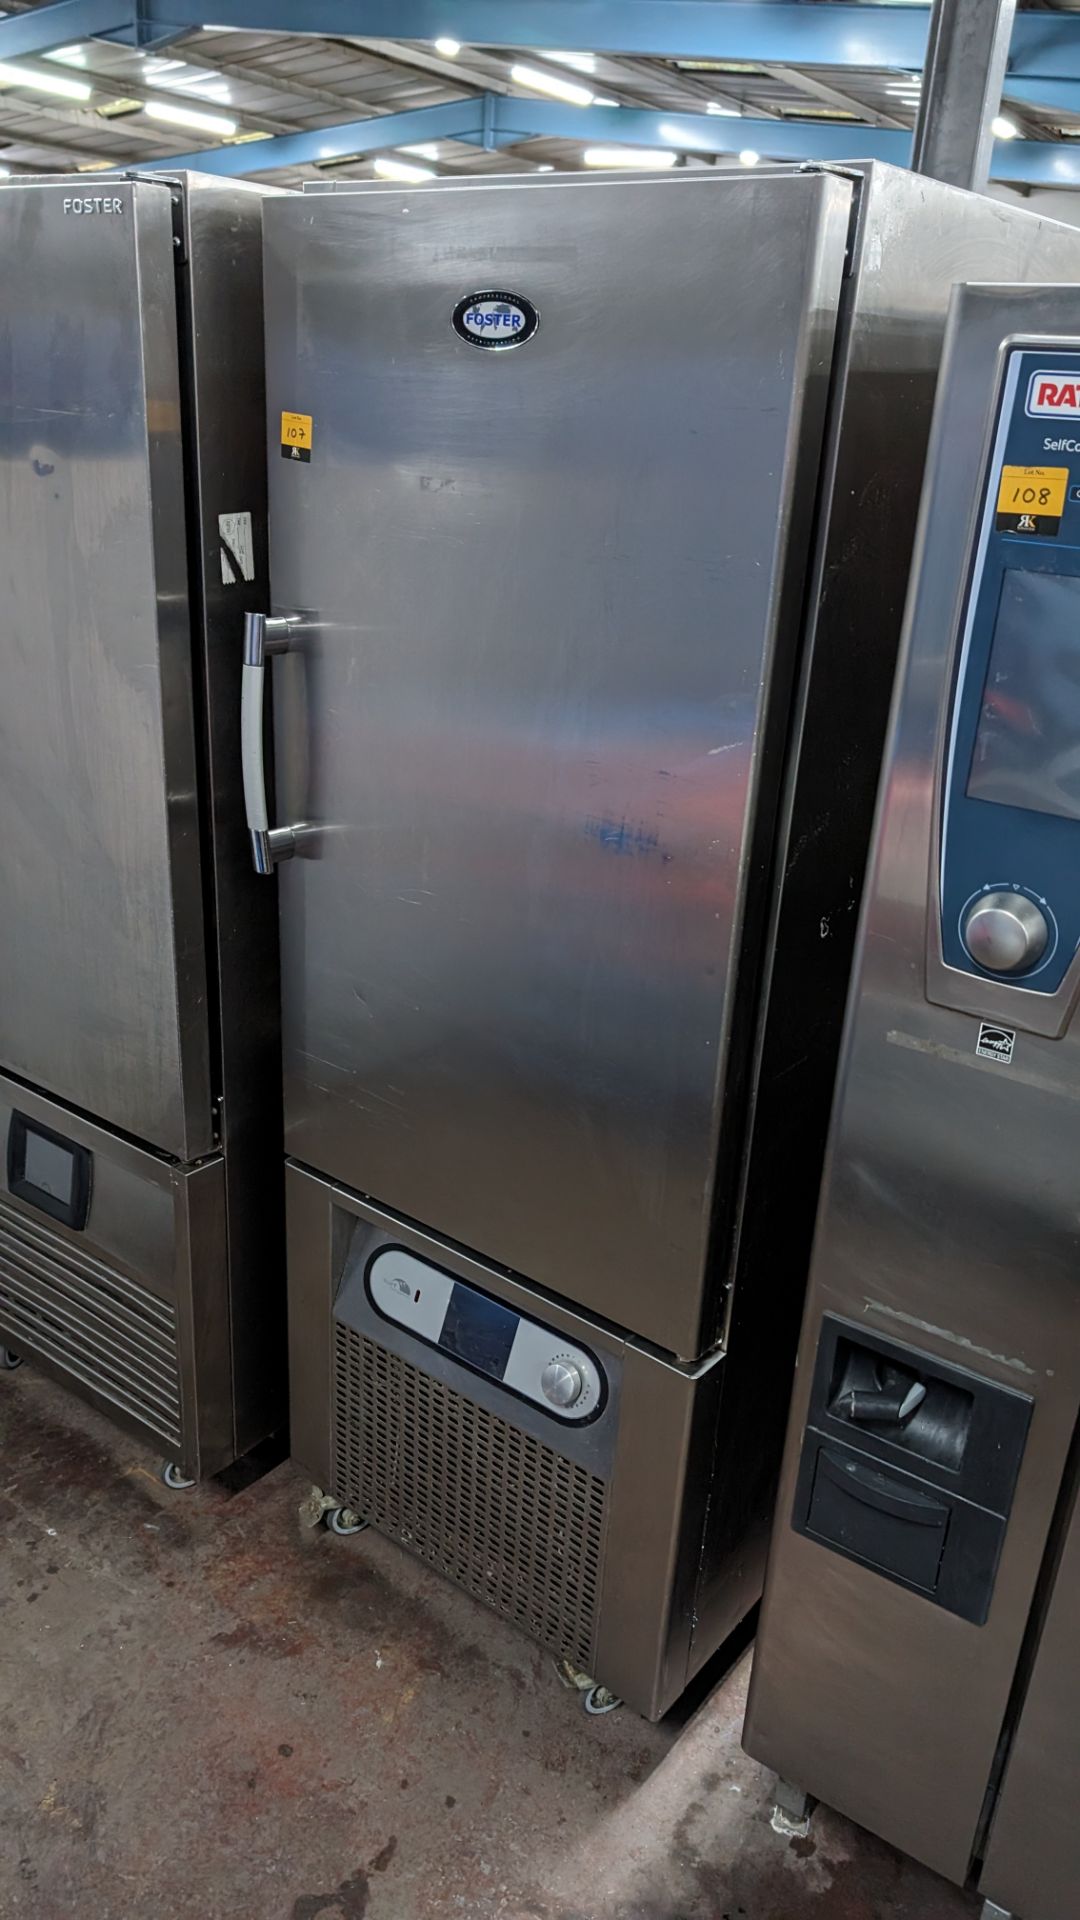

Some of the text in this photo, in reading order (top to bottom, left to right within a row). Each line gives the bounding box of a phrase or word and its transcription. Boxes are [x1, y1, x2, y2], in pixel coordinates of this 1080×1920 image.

[63, 197, 122, 214] FOSTER
[466, 312, 521, 327] FOSTER
[287, 428, 306, 440] 107
[1012, 487, 1051, 505] 108
